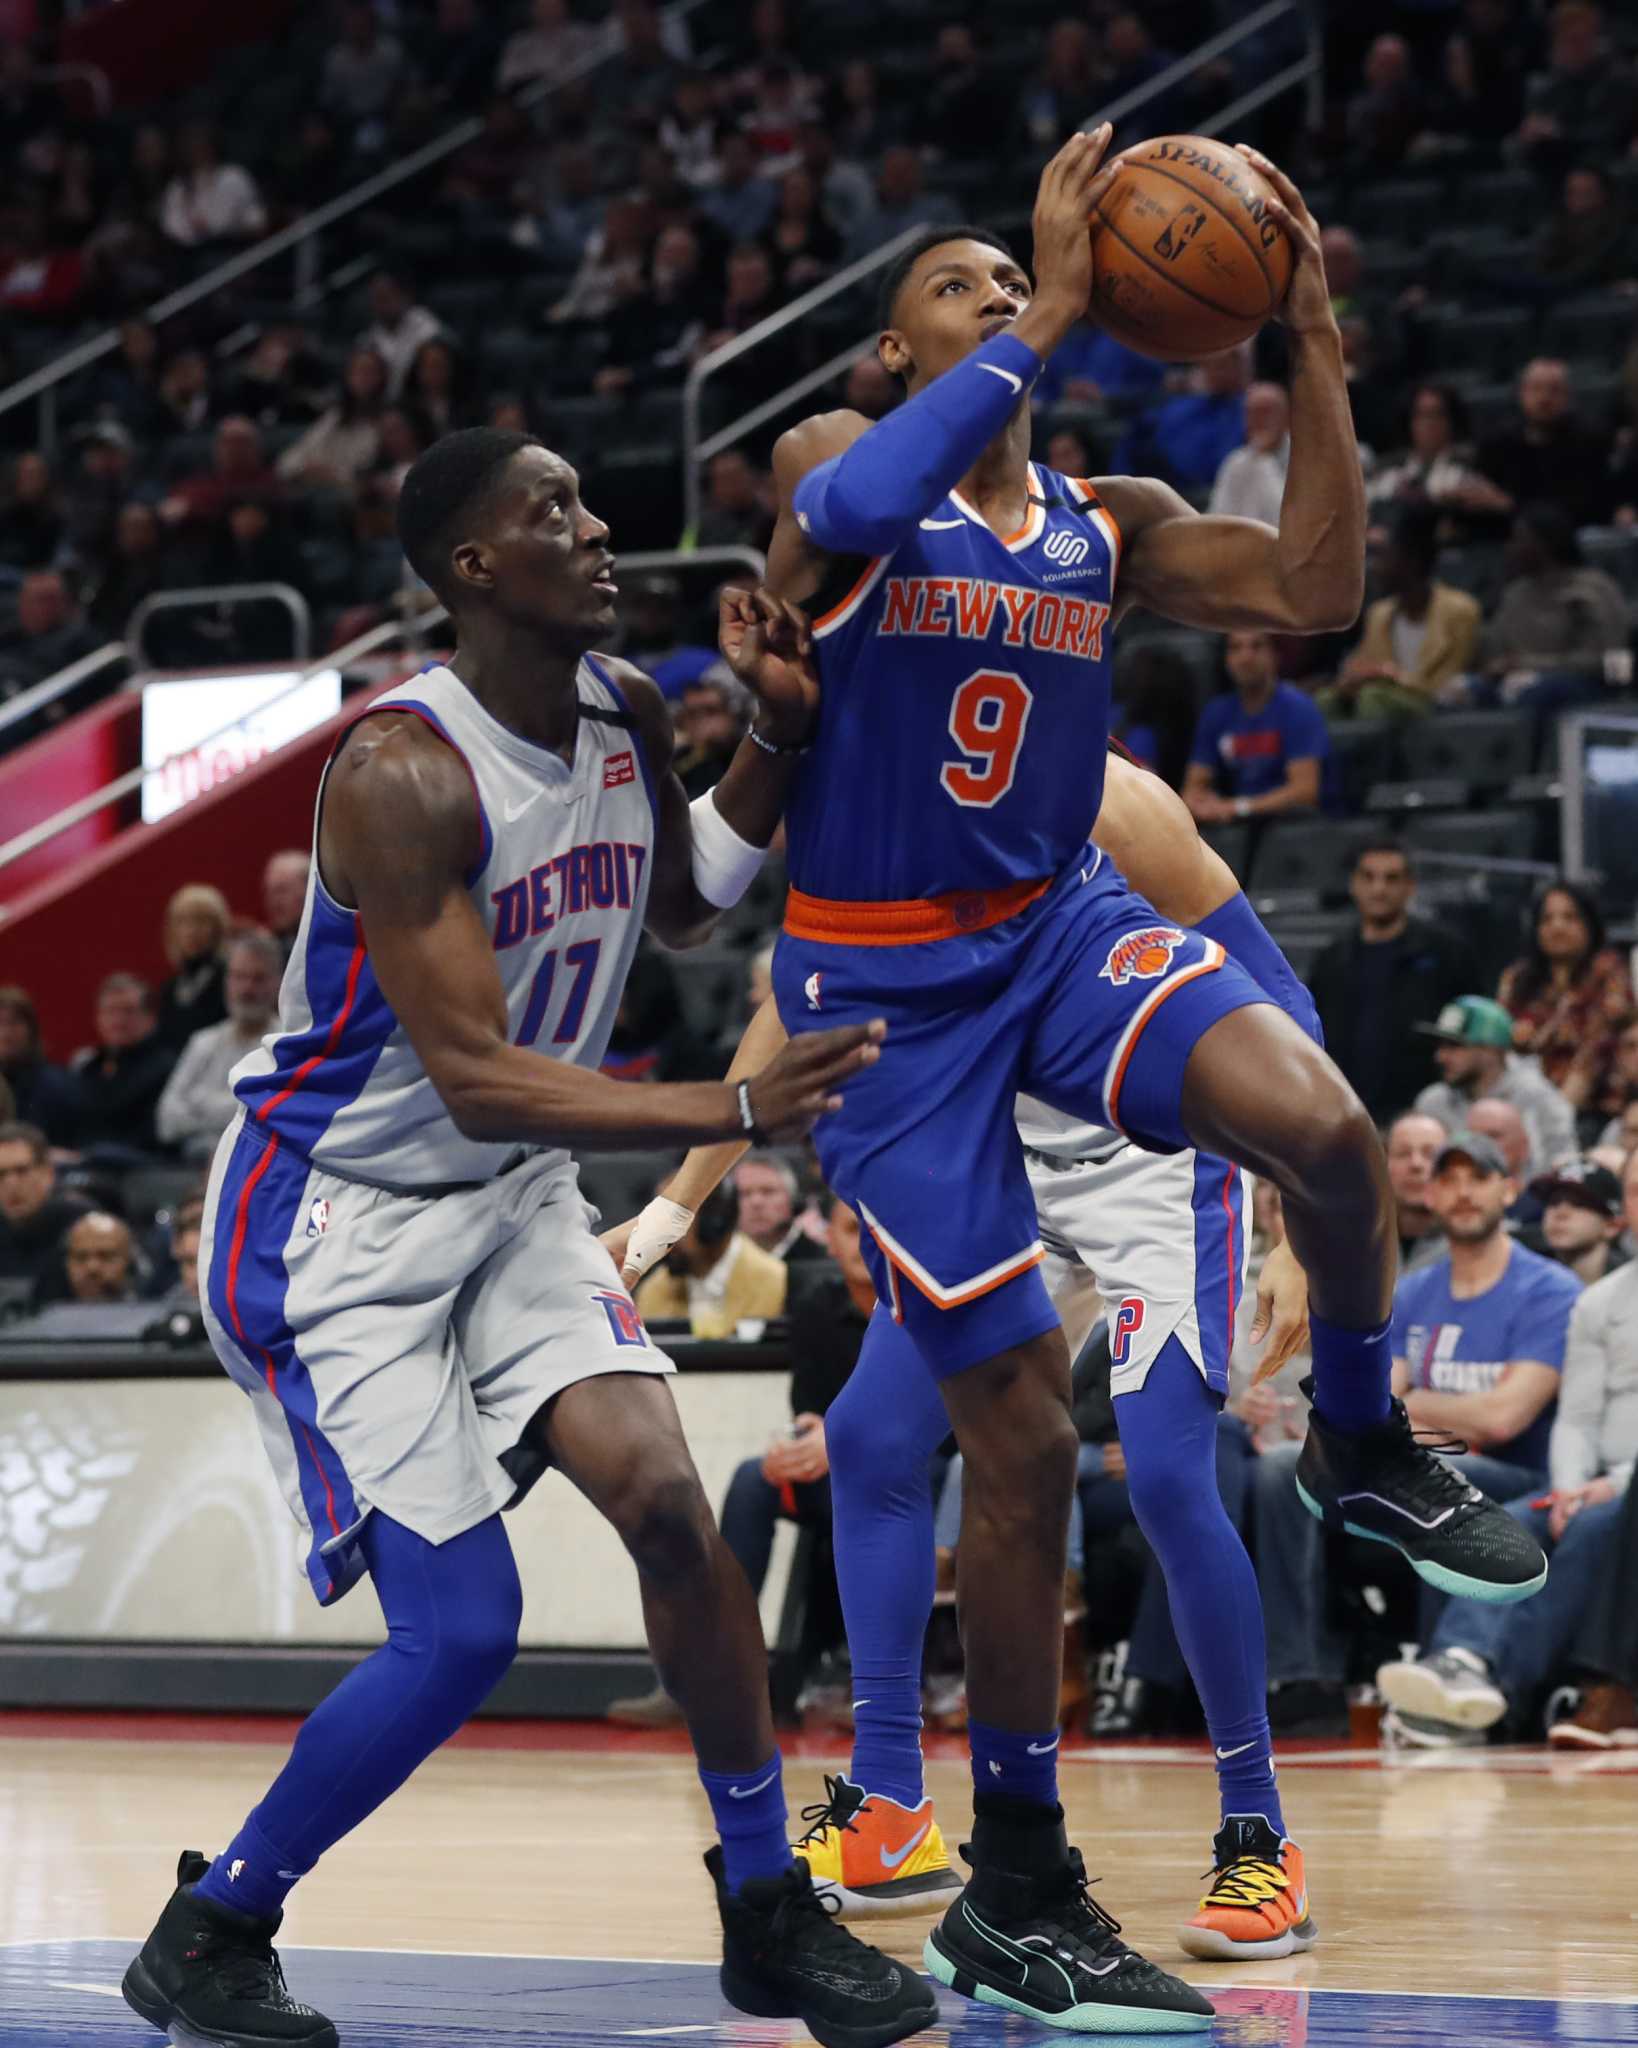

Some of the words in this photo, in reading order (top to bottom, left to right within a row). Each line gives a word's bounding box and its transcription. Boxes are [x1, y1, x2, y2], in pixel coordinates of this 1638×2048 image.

[1149, 142, 1280, 248] SPALNG
[876, 576, 999, 640] NEW
[1000, 583, 1111, 662] YORK
[1042, 567, 1102, 584] SQUARESPACE
[940, 668, 1034, 808] 9
[491, 842, 646, 950] DETROIT
[514, 938, 602, 1047] 17
